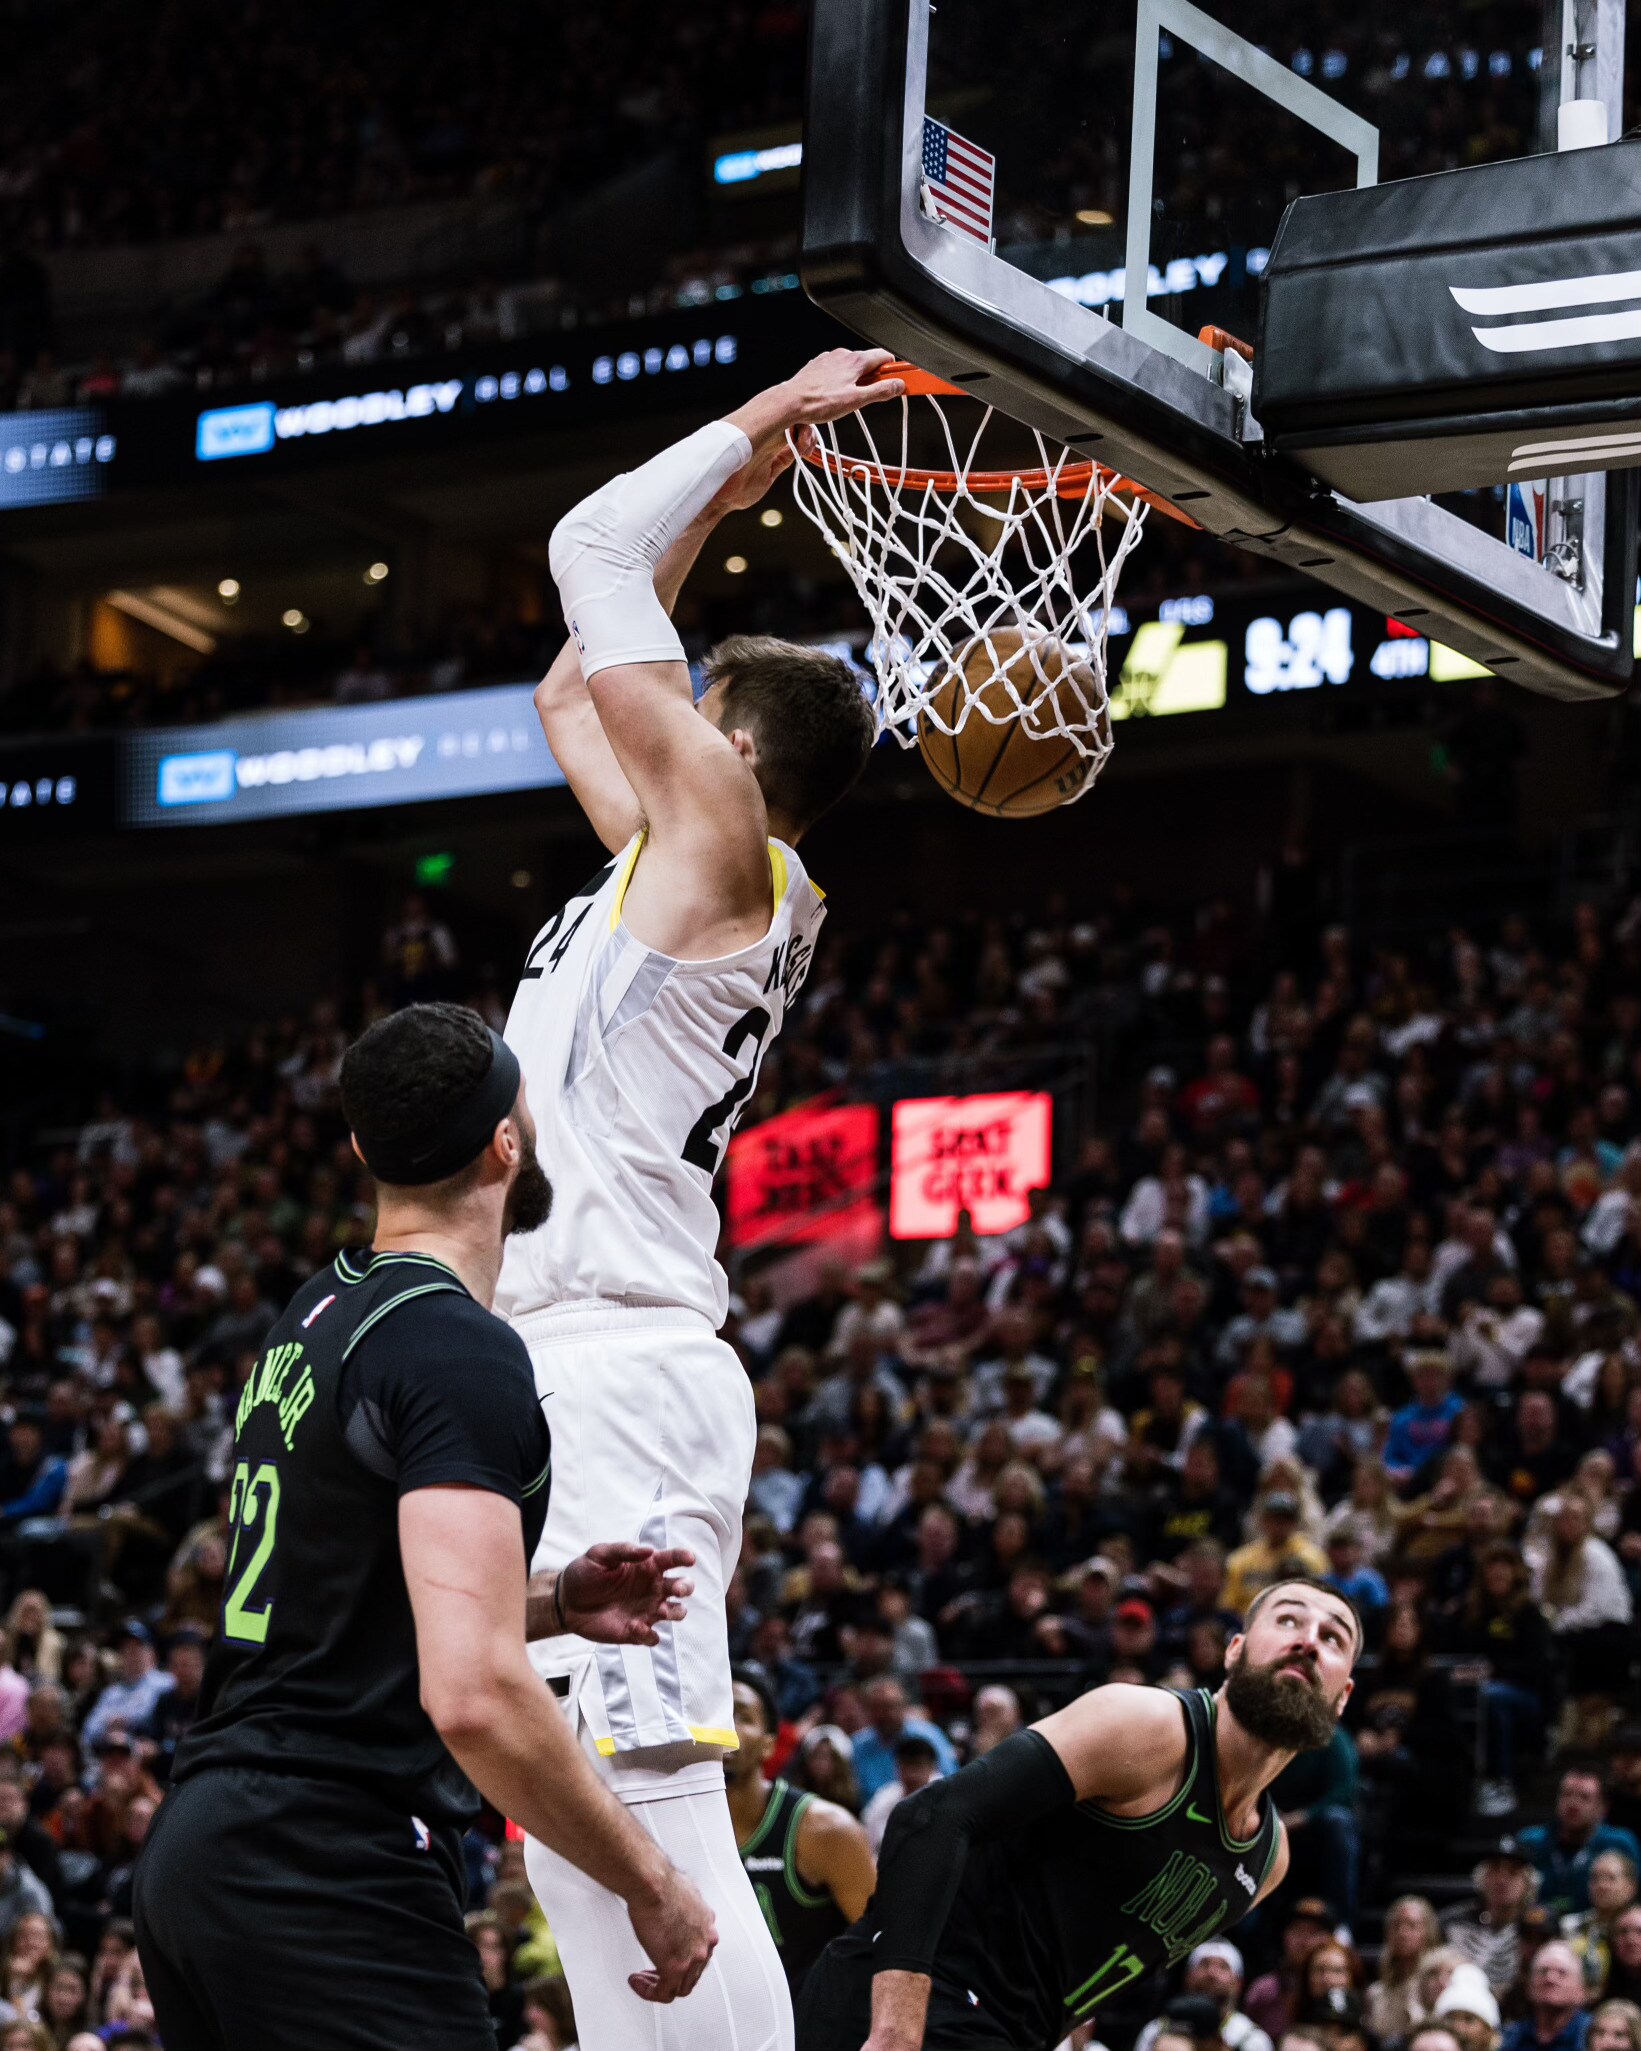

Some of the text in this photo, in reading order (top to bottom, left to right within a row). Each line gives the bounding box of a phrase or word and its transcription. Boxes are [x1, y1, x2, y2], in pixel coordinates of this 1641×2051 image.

[592, 335, 738, 385] ESTATE
[520, 902, 595, 980] 24
[681, 1006, 771, 1174] 2
[1063, 1944, 1144, 2016] 17
